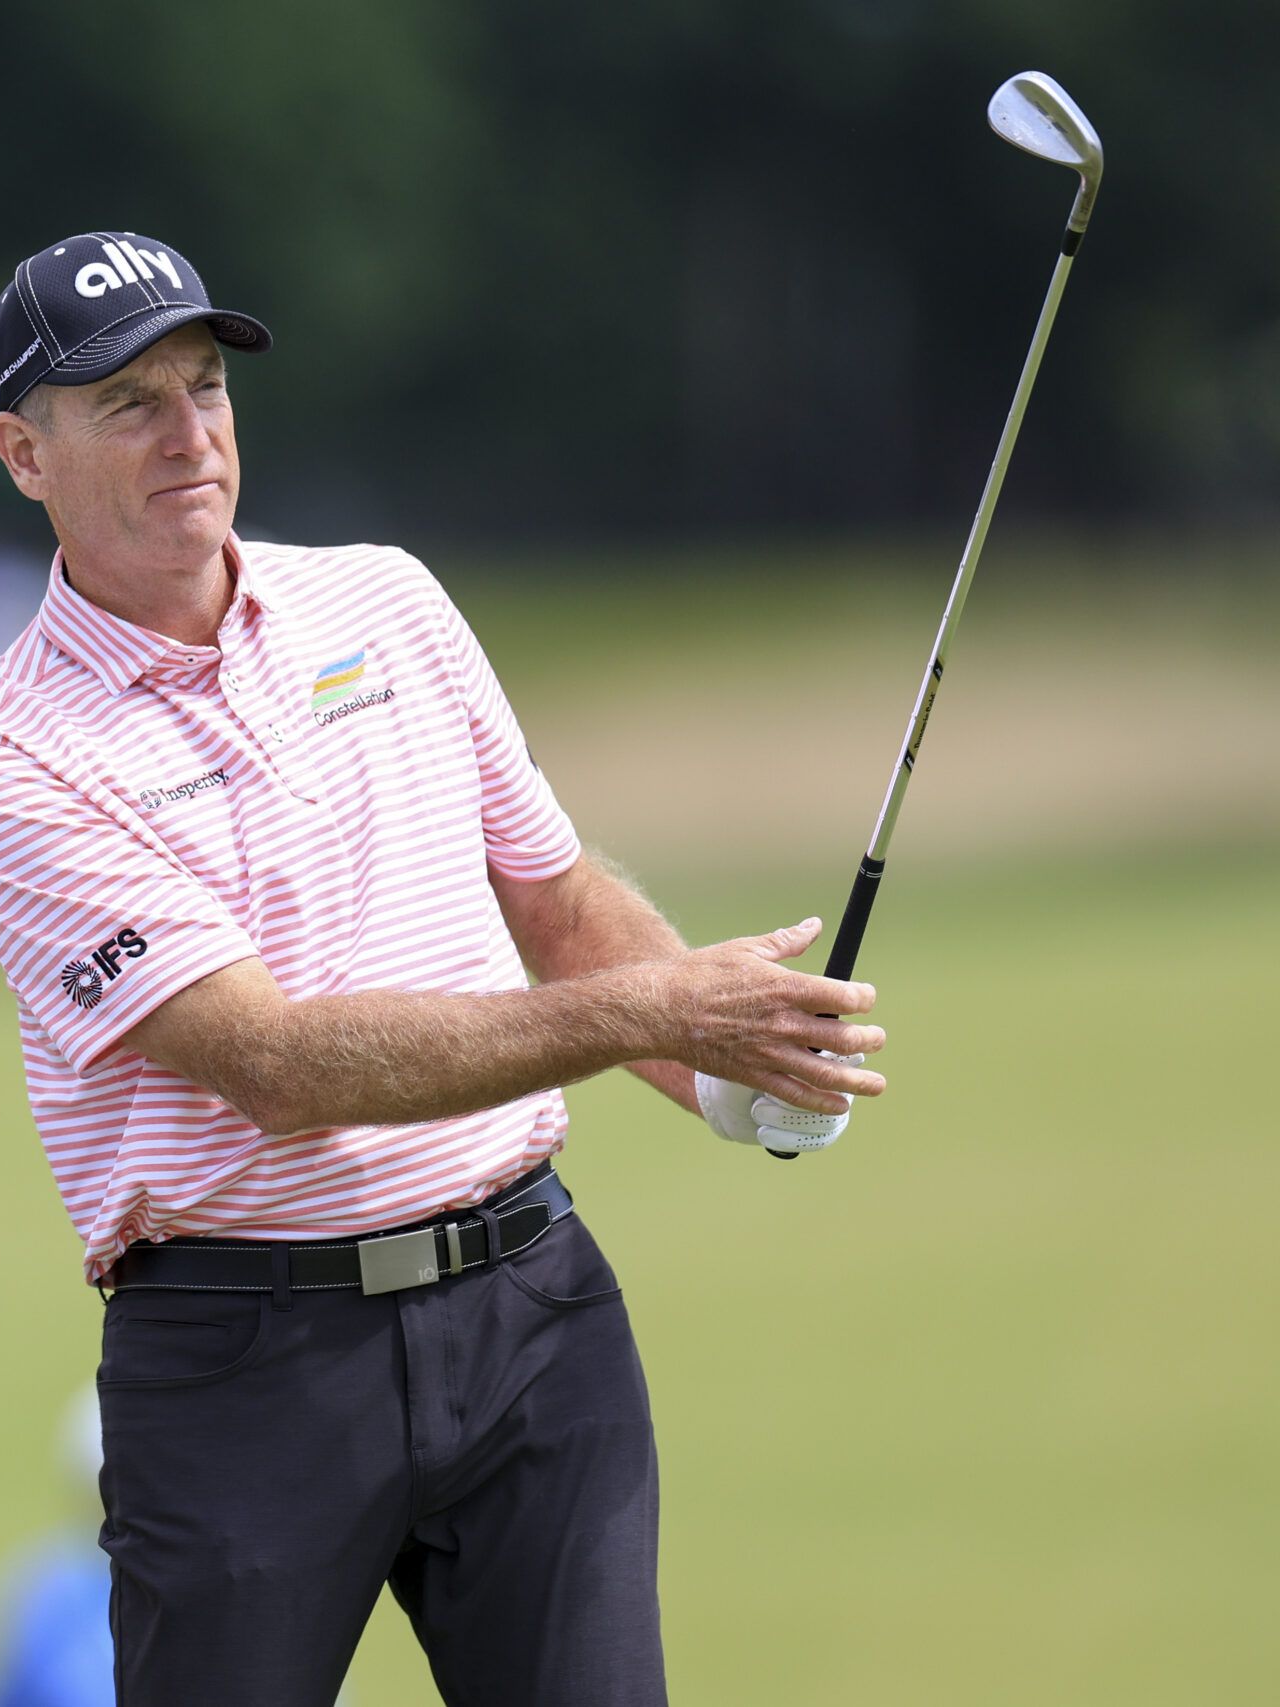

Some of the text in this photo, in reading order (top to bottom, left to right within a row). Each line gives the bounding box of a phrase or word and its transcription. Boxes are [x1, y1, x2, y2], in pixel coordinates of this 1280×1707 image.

[74, 240, 183, 299] ally
[313, 688, 396, 728] Constellation
[91, 928, 148, 982] IFS
